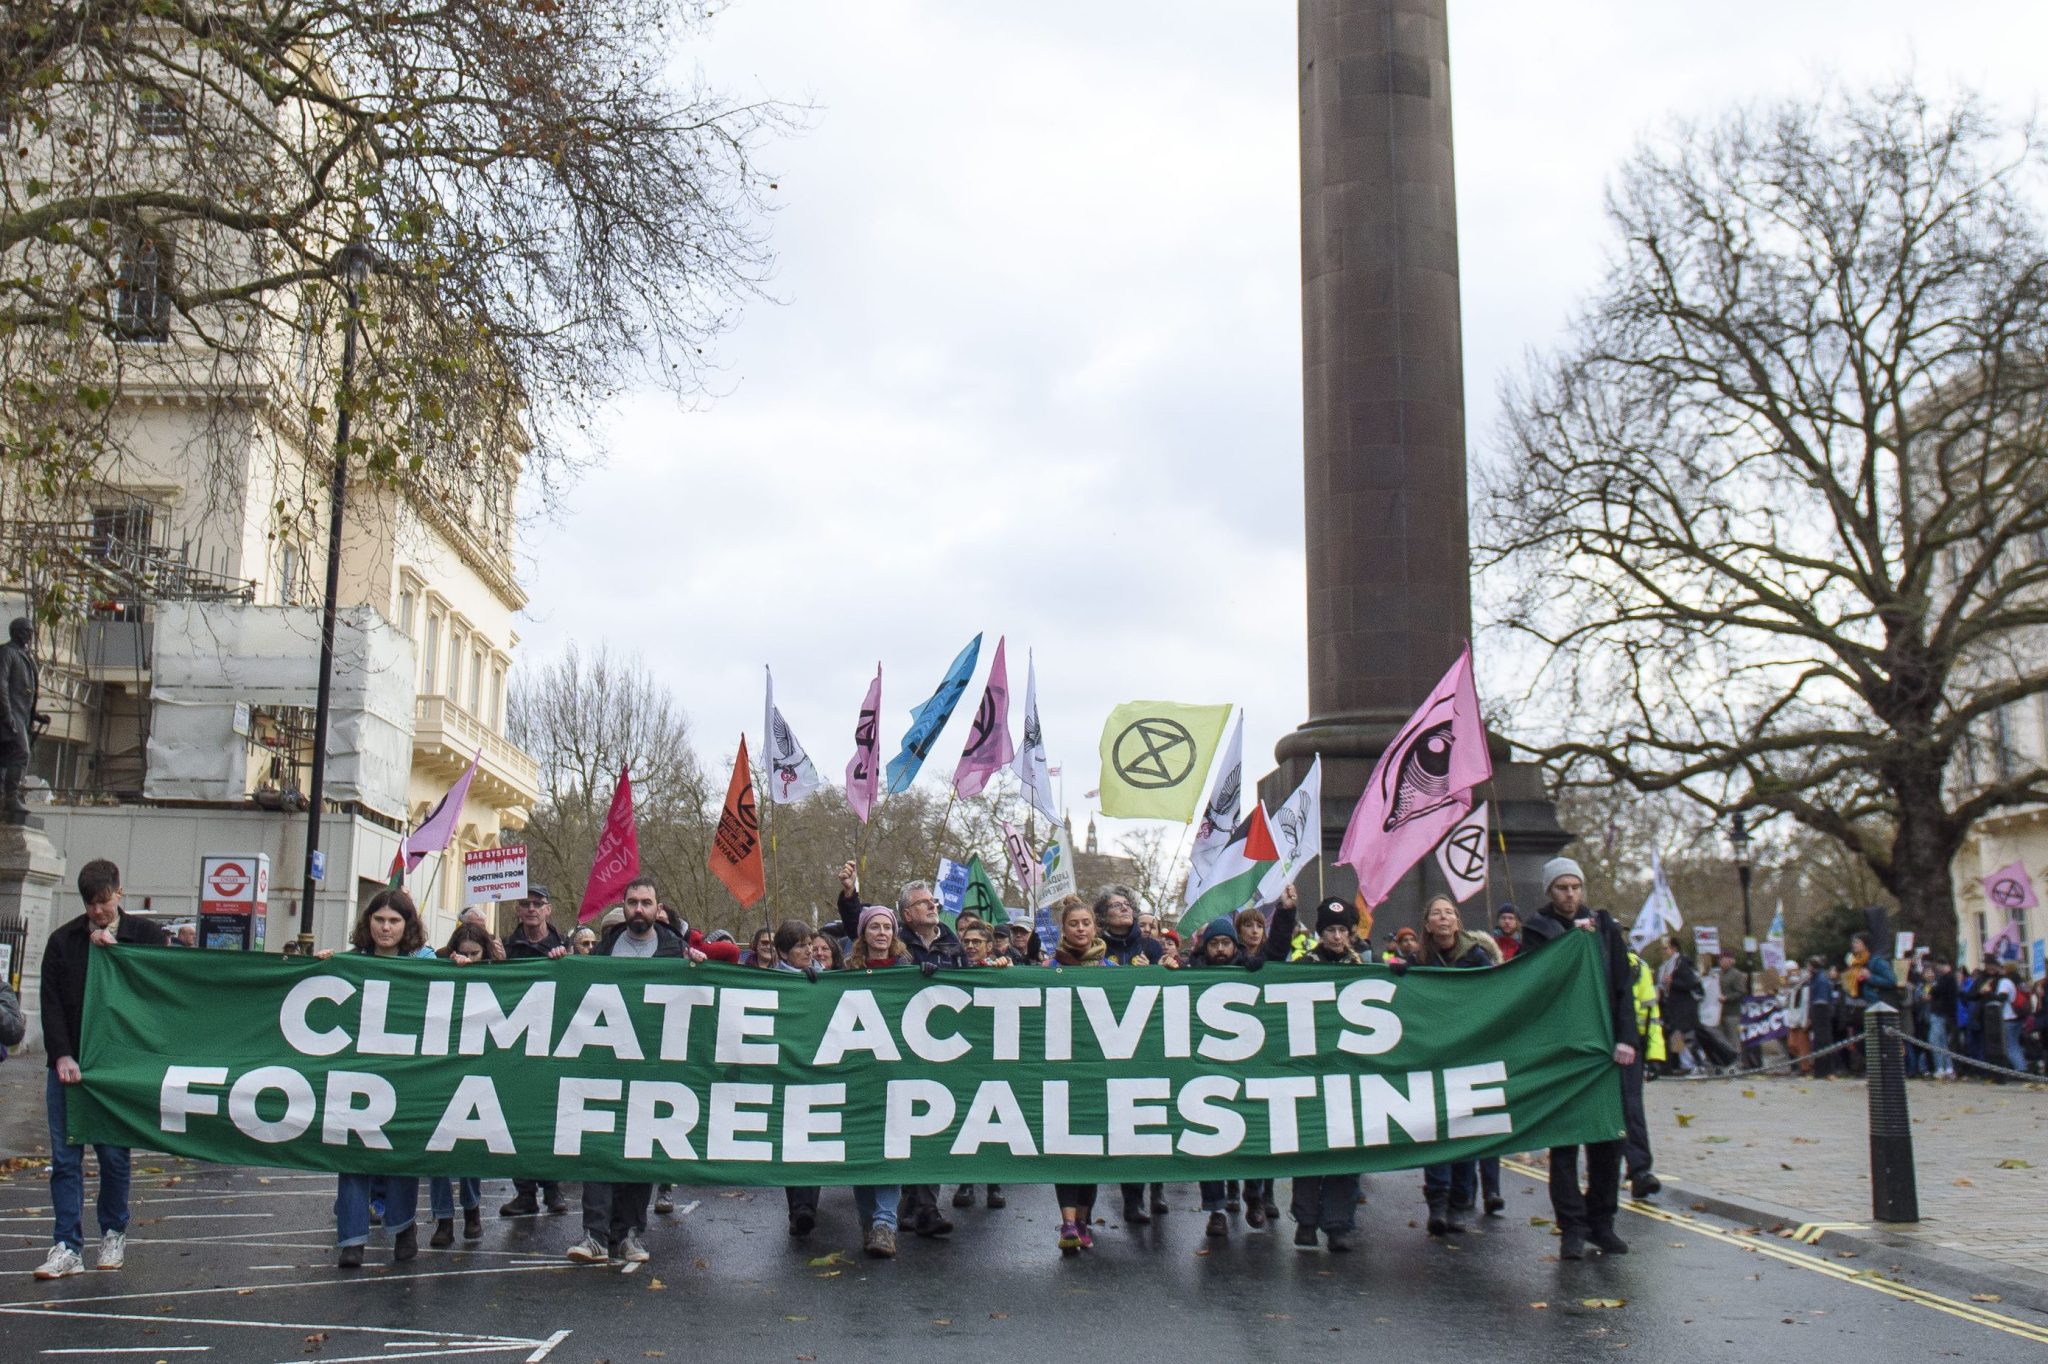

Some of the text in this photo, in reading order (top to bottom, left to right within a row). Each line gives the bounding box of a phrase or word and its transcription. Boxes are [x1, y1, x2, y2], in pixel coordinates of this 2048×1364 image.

[467, 847, 523, 860] BAE SYSTEMS
[468, 870, 524, 882] PROFITING FROM
[473, 881, 520, 893] DESTRUCTION
[280, 975, 1402, 1065] CLIMATE ACTIVISTS
[160, 1060, 1513, 1163] FOR A FREE PALESTINE
